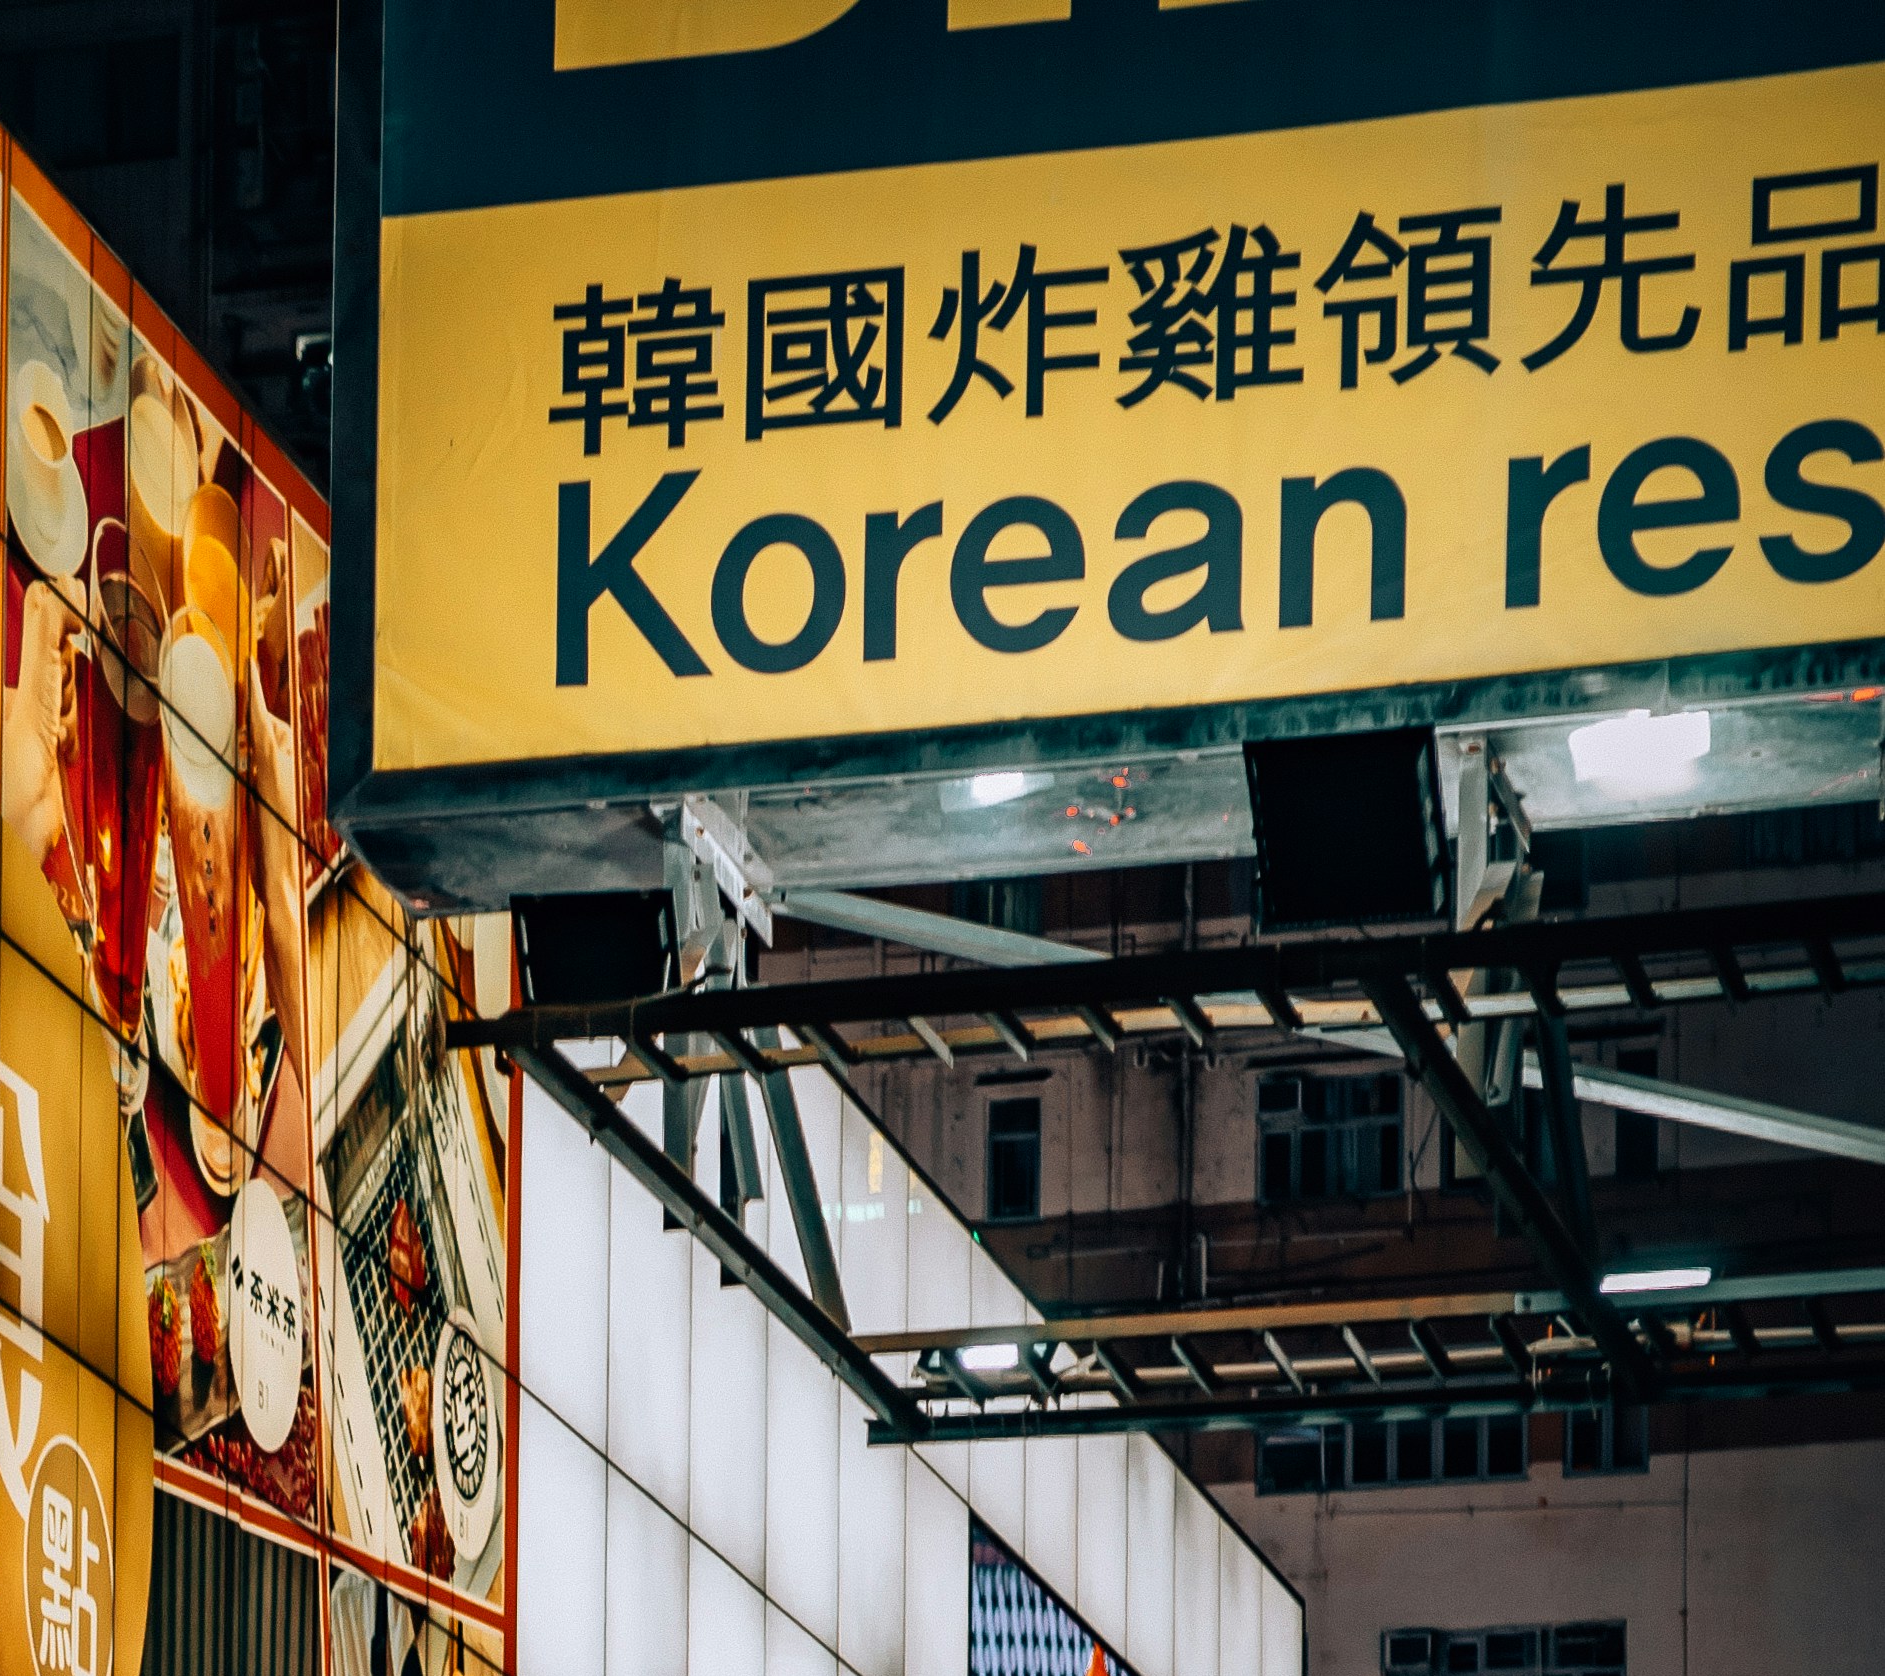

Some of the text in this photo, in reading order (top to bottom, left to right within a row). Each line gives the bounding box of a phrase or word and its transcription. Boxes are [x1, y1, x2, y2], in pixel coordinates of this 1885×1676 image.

[548, 162, 1885, 456] 韓國炸雞領先品
[556, 418, 1885, 688] Korean res
[249, 1270, 297, 1342] 茶米茶
